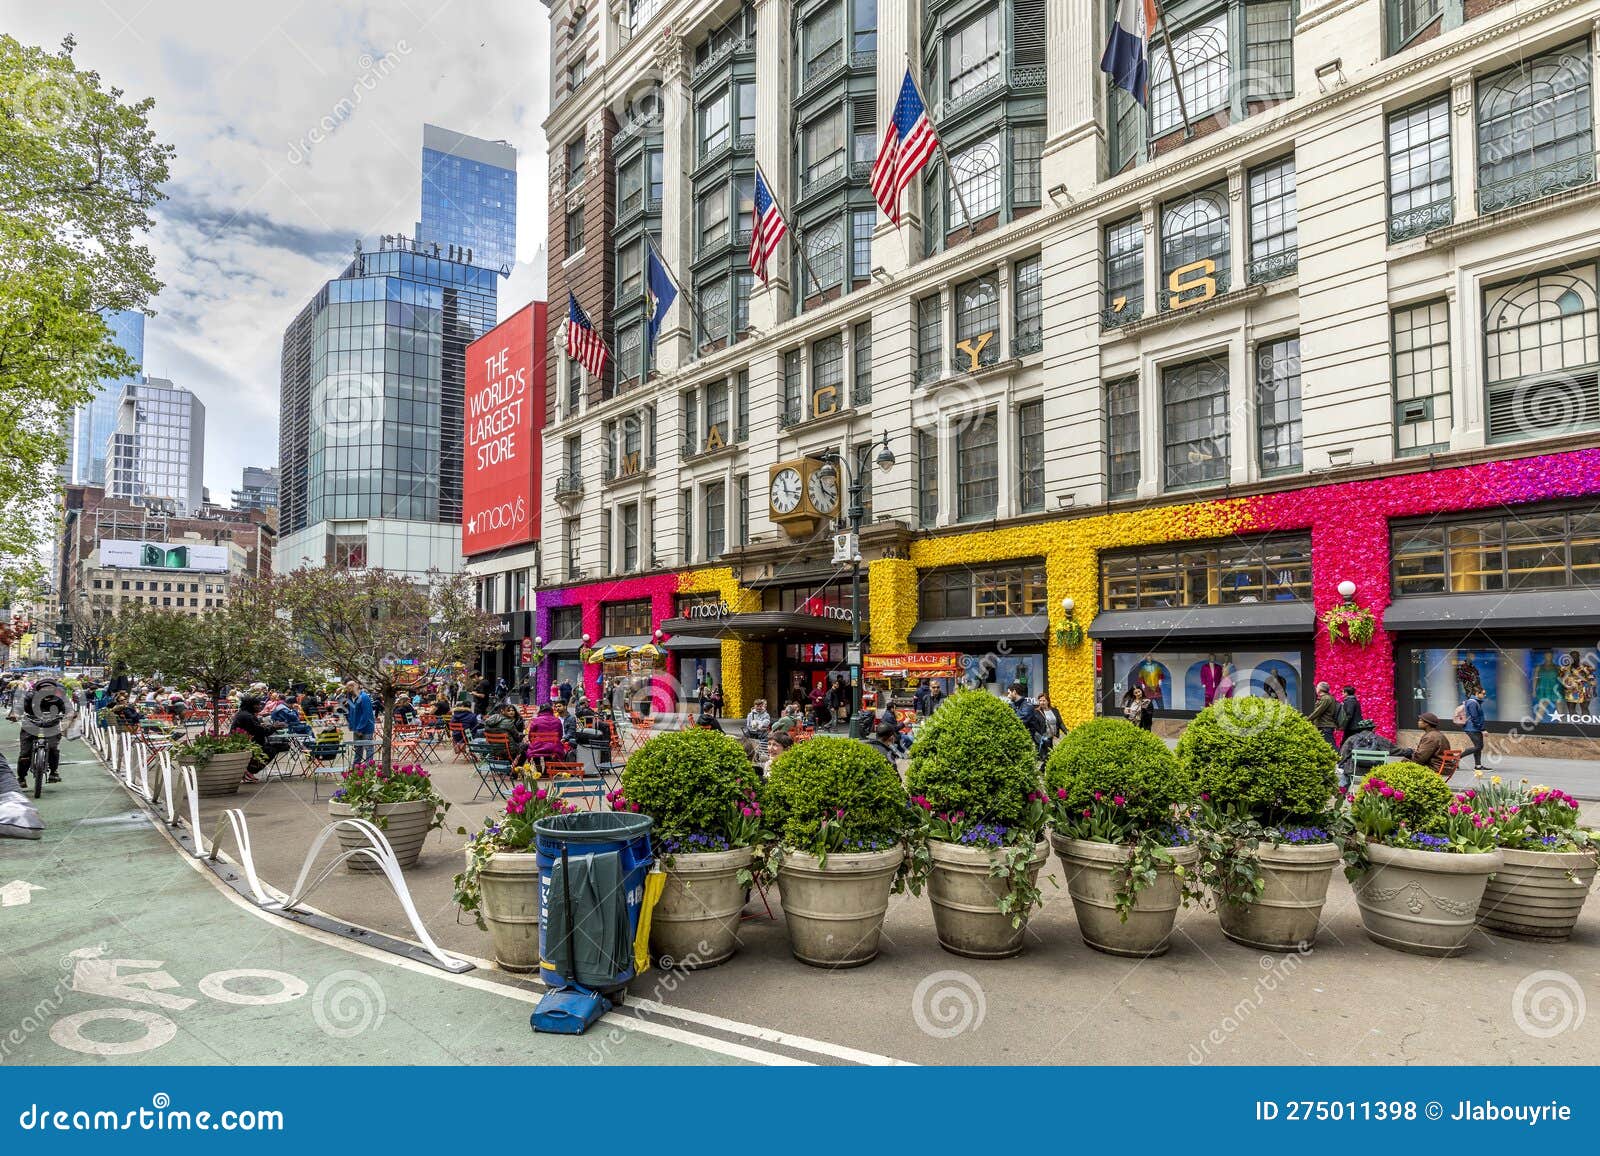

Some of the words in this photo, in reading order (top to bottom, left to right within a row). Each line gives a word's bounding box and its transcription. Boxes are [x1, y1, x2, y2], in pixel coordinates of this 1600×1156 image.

[485, 346, 510, 383] THE
[470, 367, 526, 418] WORLD'S
[469, 397, 524, 446] LARGEST
[477, 432, 516, 471] STORE
[476, 495, 526, 534] macy's
[690, 599, 730, 619] macy's
[907, 654, 938, 664] PLACE
[1567, 713, 1600, 724] ICON
